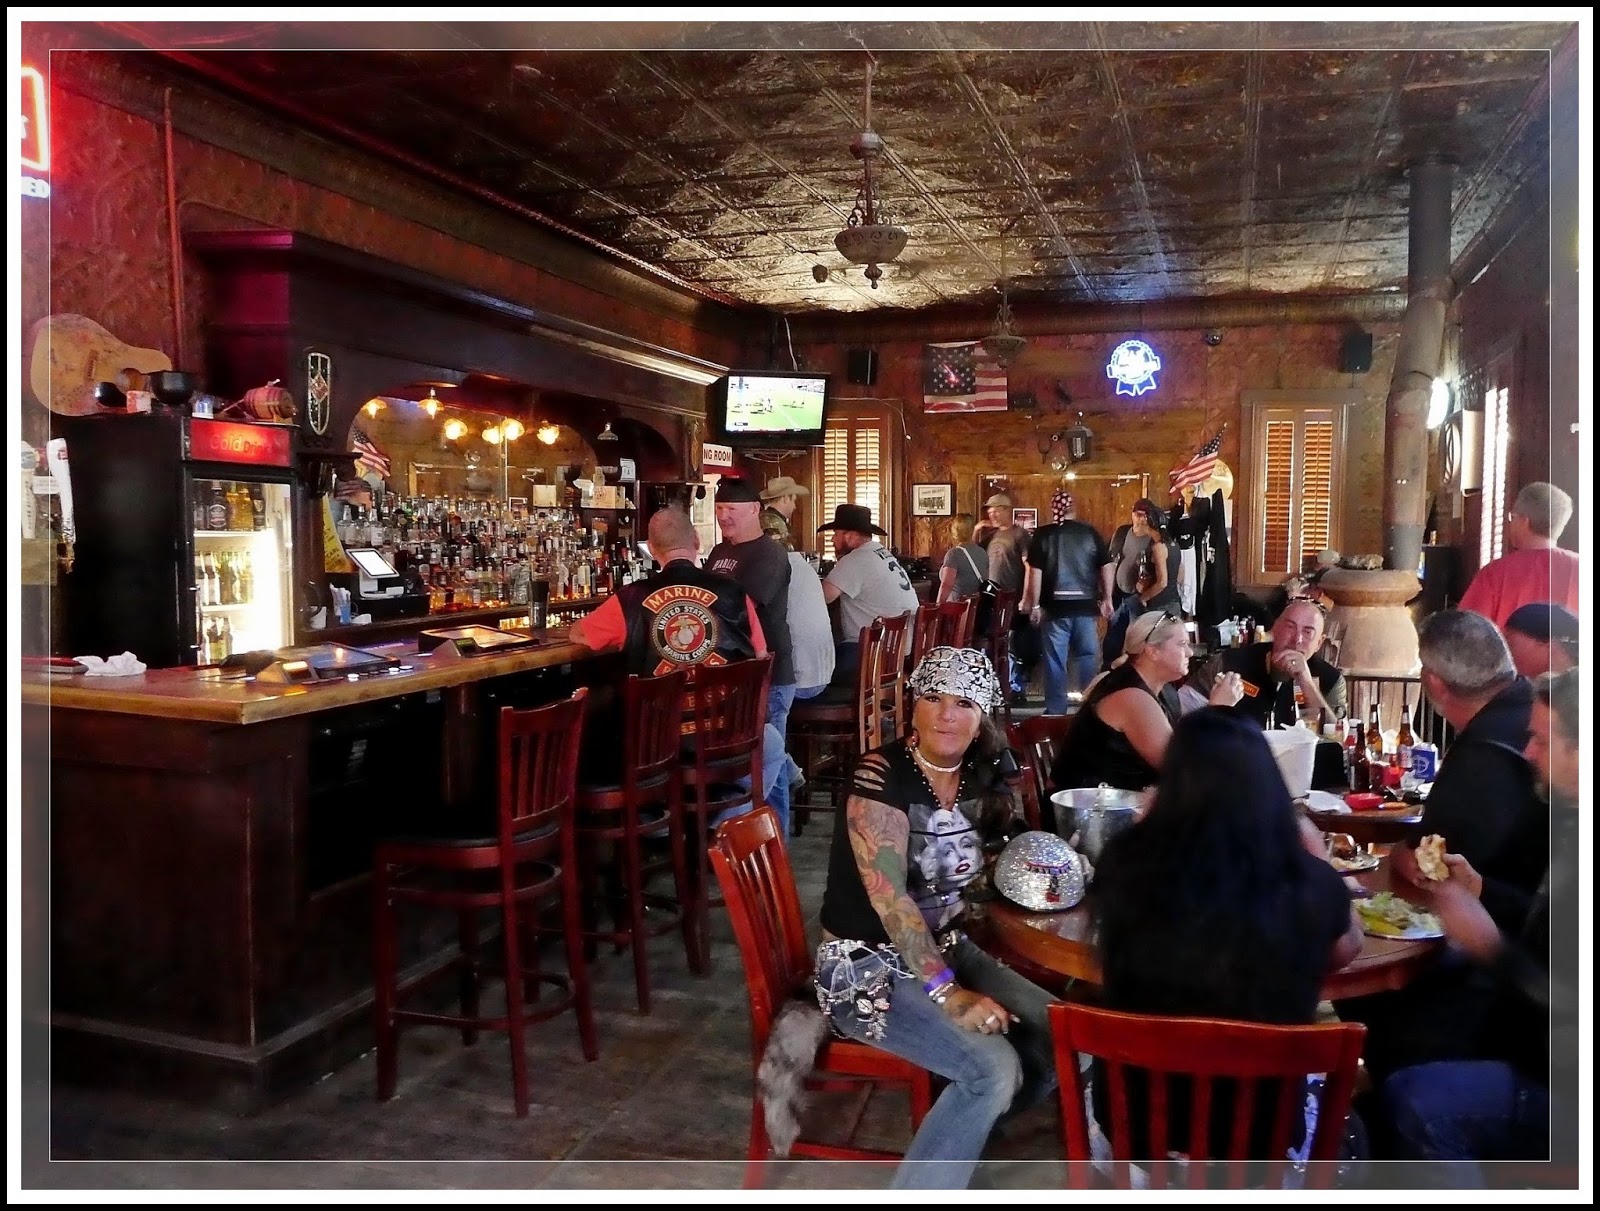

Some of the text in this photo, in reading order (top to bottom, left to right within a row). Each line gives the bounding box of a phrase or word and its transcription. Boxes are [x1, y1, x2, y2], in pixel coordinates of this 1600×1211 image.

[210, 433, 243, 453] Cold
[714, 450, 731, 462] ROOM
[648, 587, 712, 609] MARINE
[658, 605, 710, 631] UNITED STATES
[662, 638, 711, 661] MARINE CORPS
